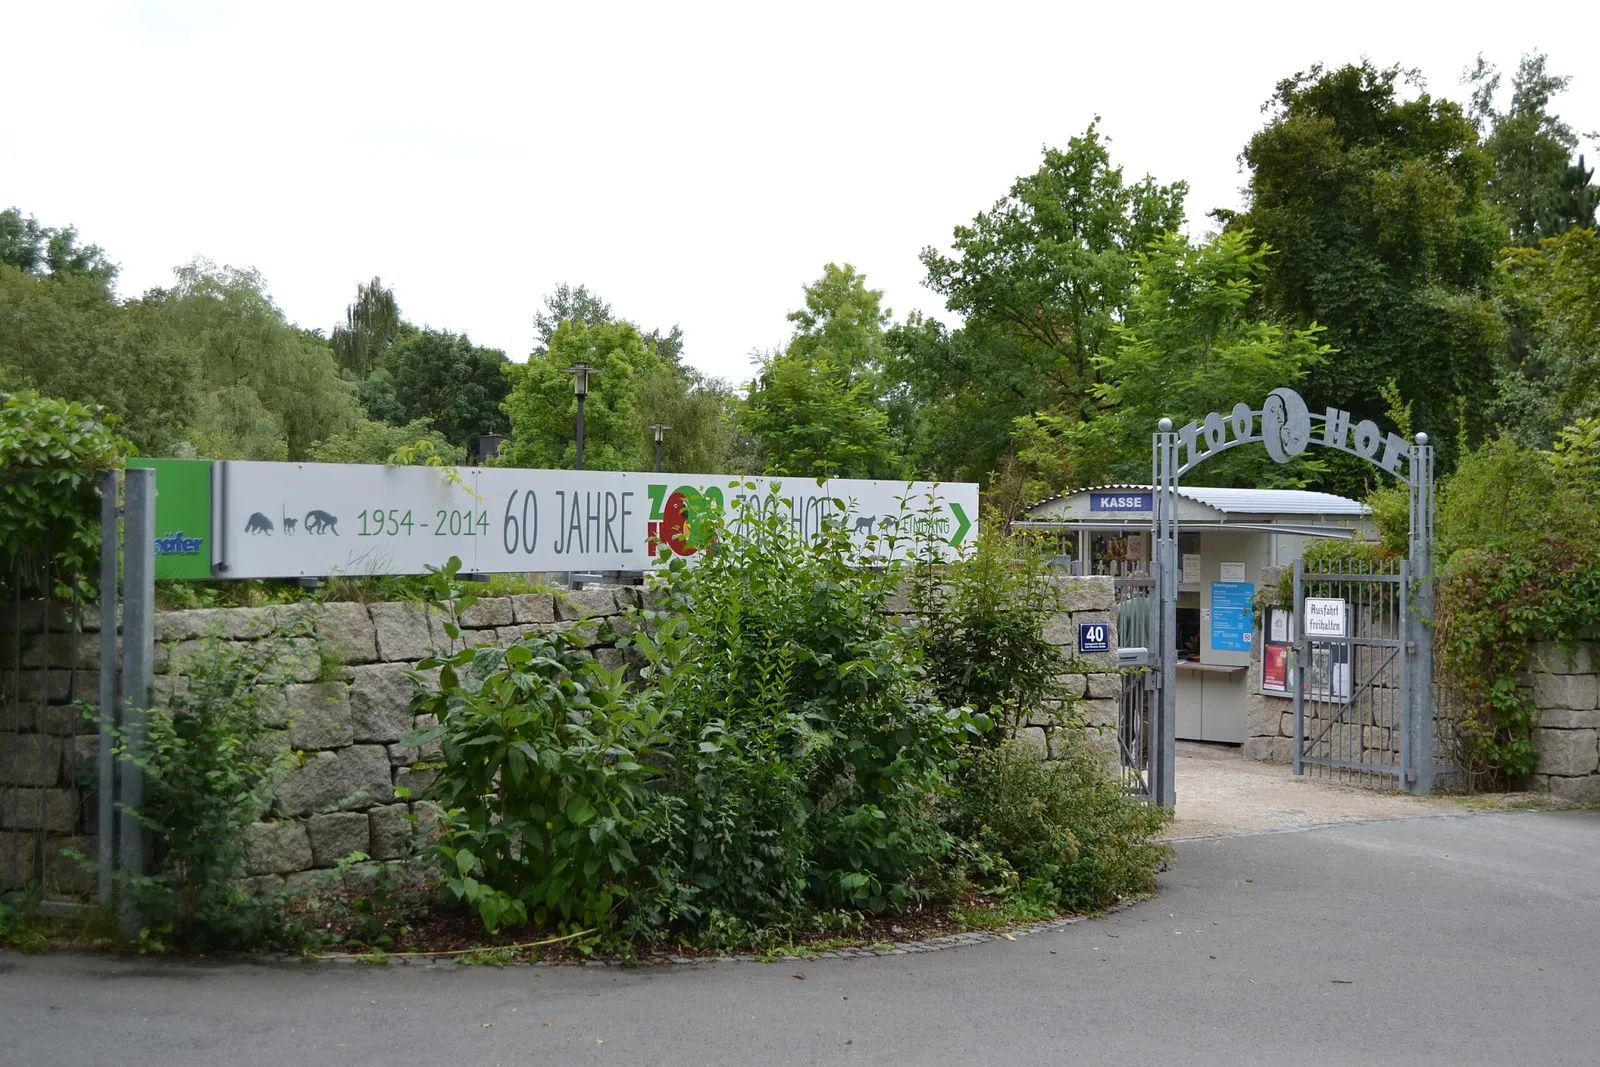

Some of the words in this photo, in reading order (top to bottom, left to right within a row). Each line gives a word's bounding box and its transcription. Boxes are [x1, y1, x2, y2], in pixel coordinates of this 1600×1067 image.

[1178, 402, 1251, 466] ZOO
[1324, 407, 1410, 473] HOF
[1100, 497, 1142, 508] KASSE
[357, 509, 414, 536] 1954
[434, 509, 490, 536] 2014
[503, 489, 538, 555] 60
[554, 490, 634, 554] JAHRE
[1310, 604, 1339, 616] Ausfahrt
[1309, 618, 1341, 631] freihalten
[1086, 626, 1104, 642] 40
